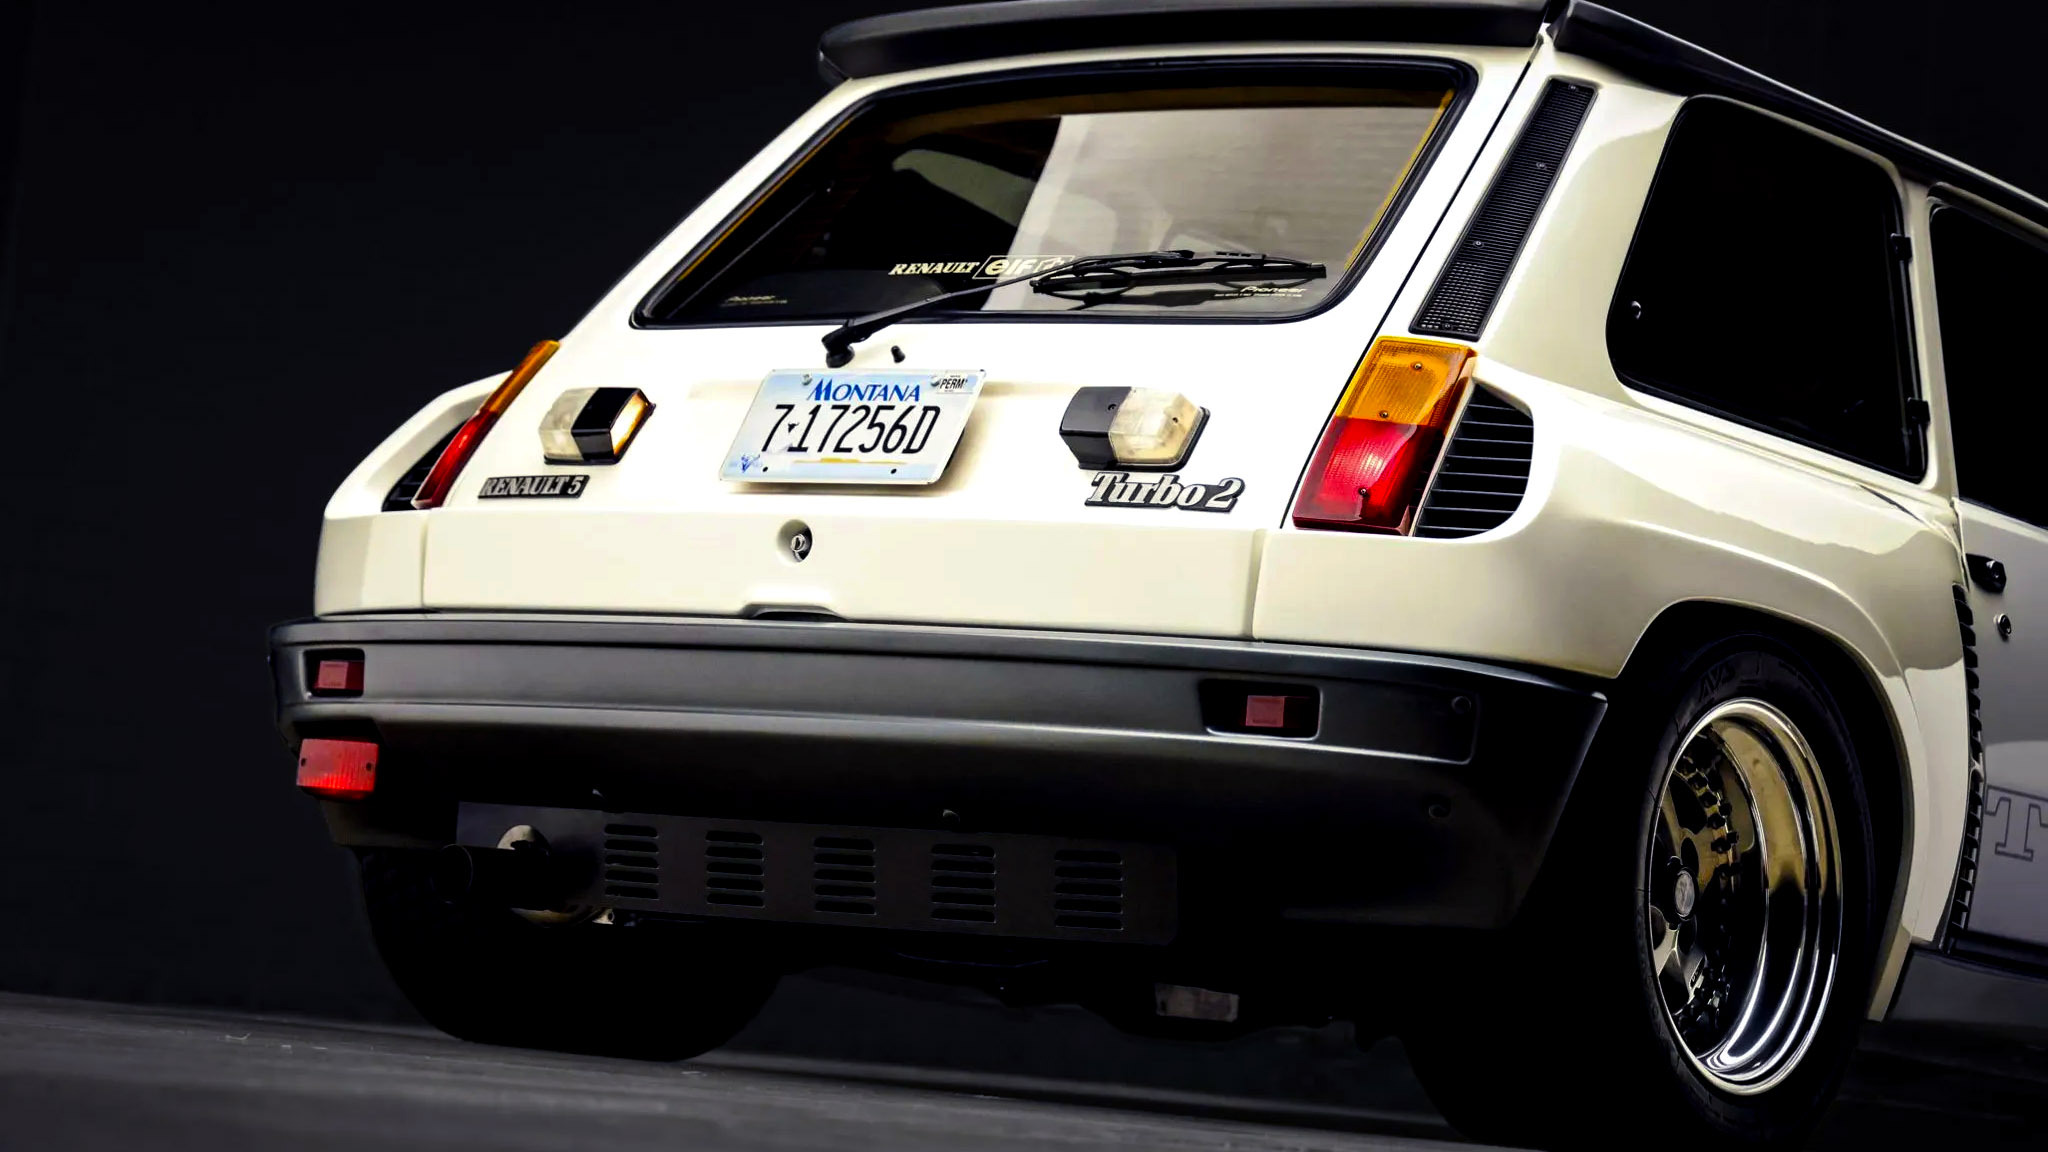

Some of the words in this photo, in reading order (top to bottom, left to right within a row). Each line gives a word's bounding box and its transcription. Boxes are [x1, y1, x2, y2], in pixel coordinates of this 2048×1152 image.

[888, 261, 980, 275] RENAULT
[806, 378, 920, 402] MONTANA
[480, 477, 569, 496] RENAULT
[567, 476, 585, 495] 5
[1088, 472, 1206, 507] Turbo
[1205, 478, 1245, 509] 2
